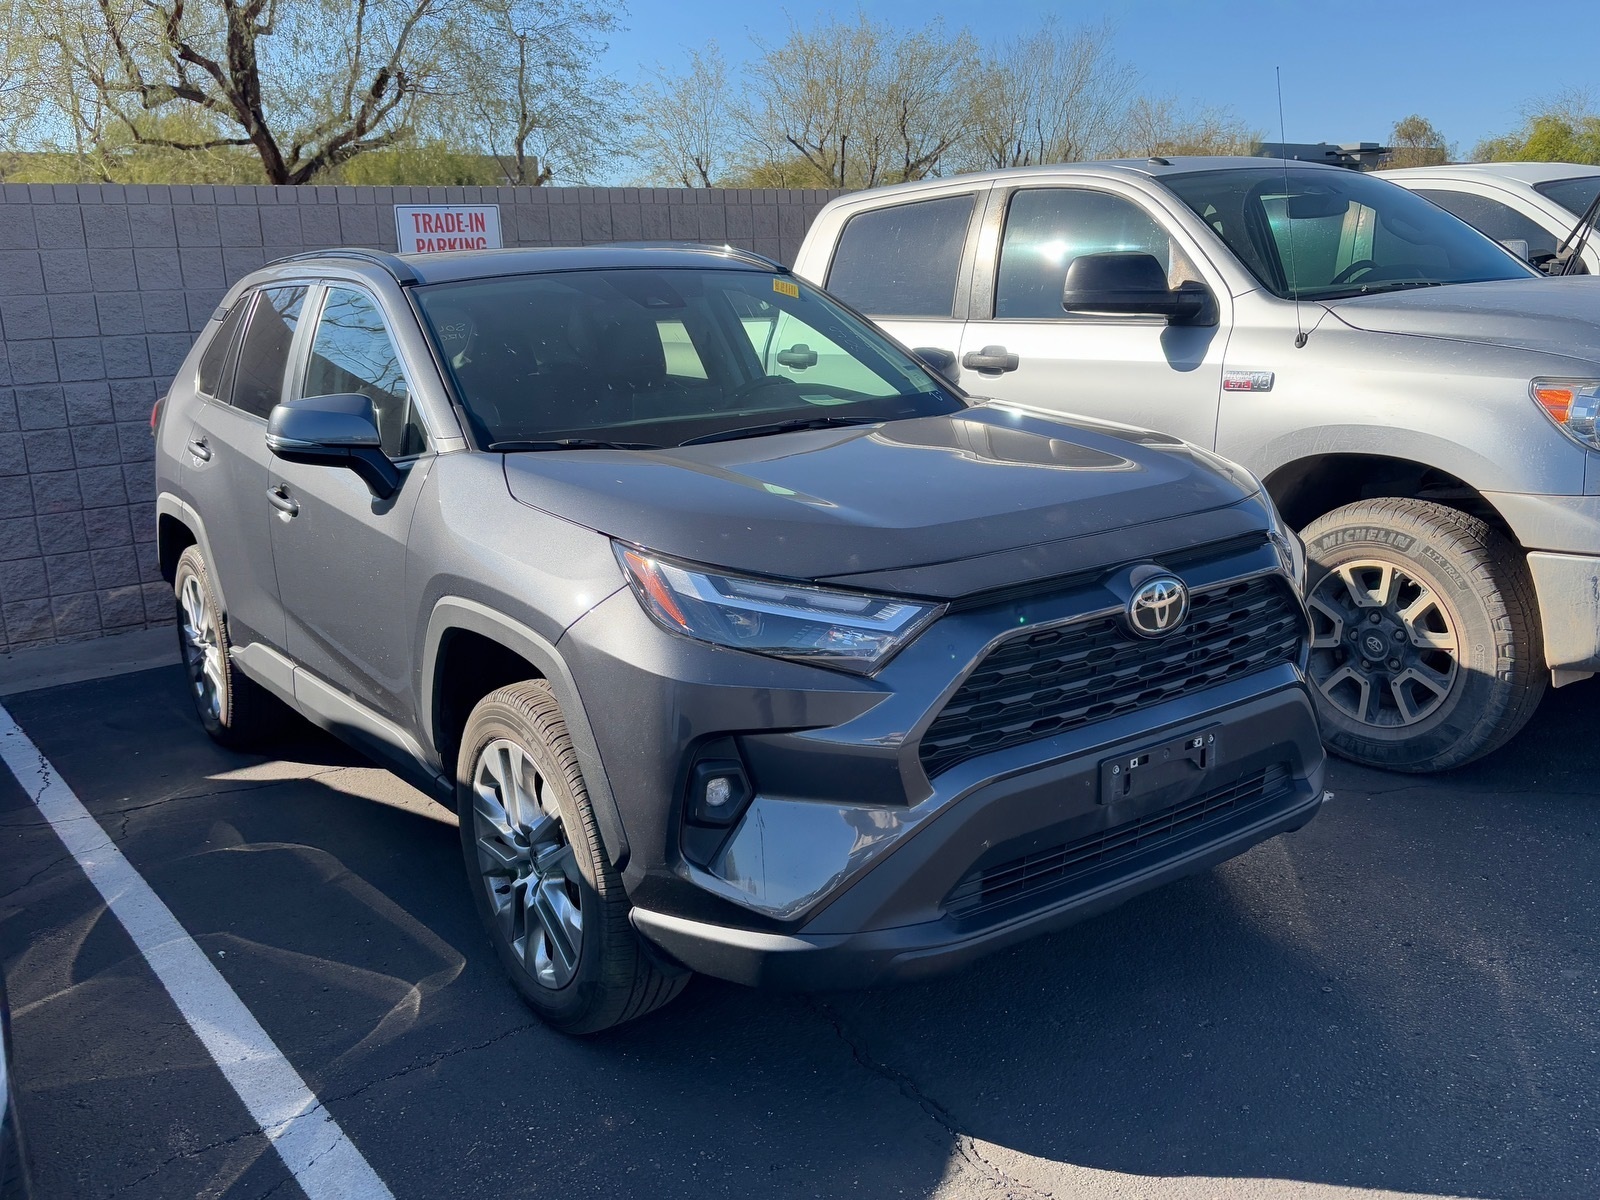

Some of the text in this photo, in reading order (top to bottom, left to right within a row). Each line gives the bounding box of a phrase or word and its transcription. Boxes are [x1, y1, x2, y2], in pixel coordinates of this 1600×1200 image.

[411, 212, 486, 233] TRADE-IN
[415, 236, 487, 252] PARKING
[1322, 529, 1411, 550] MICHELIN
